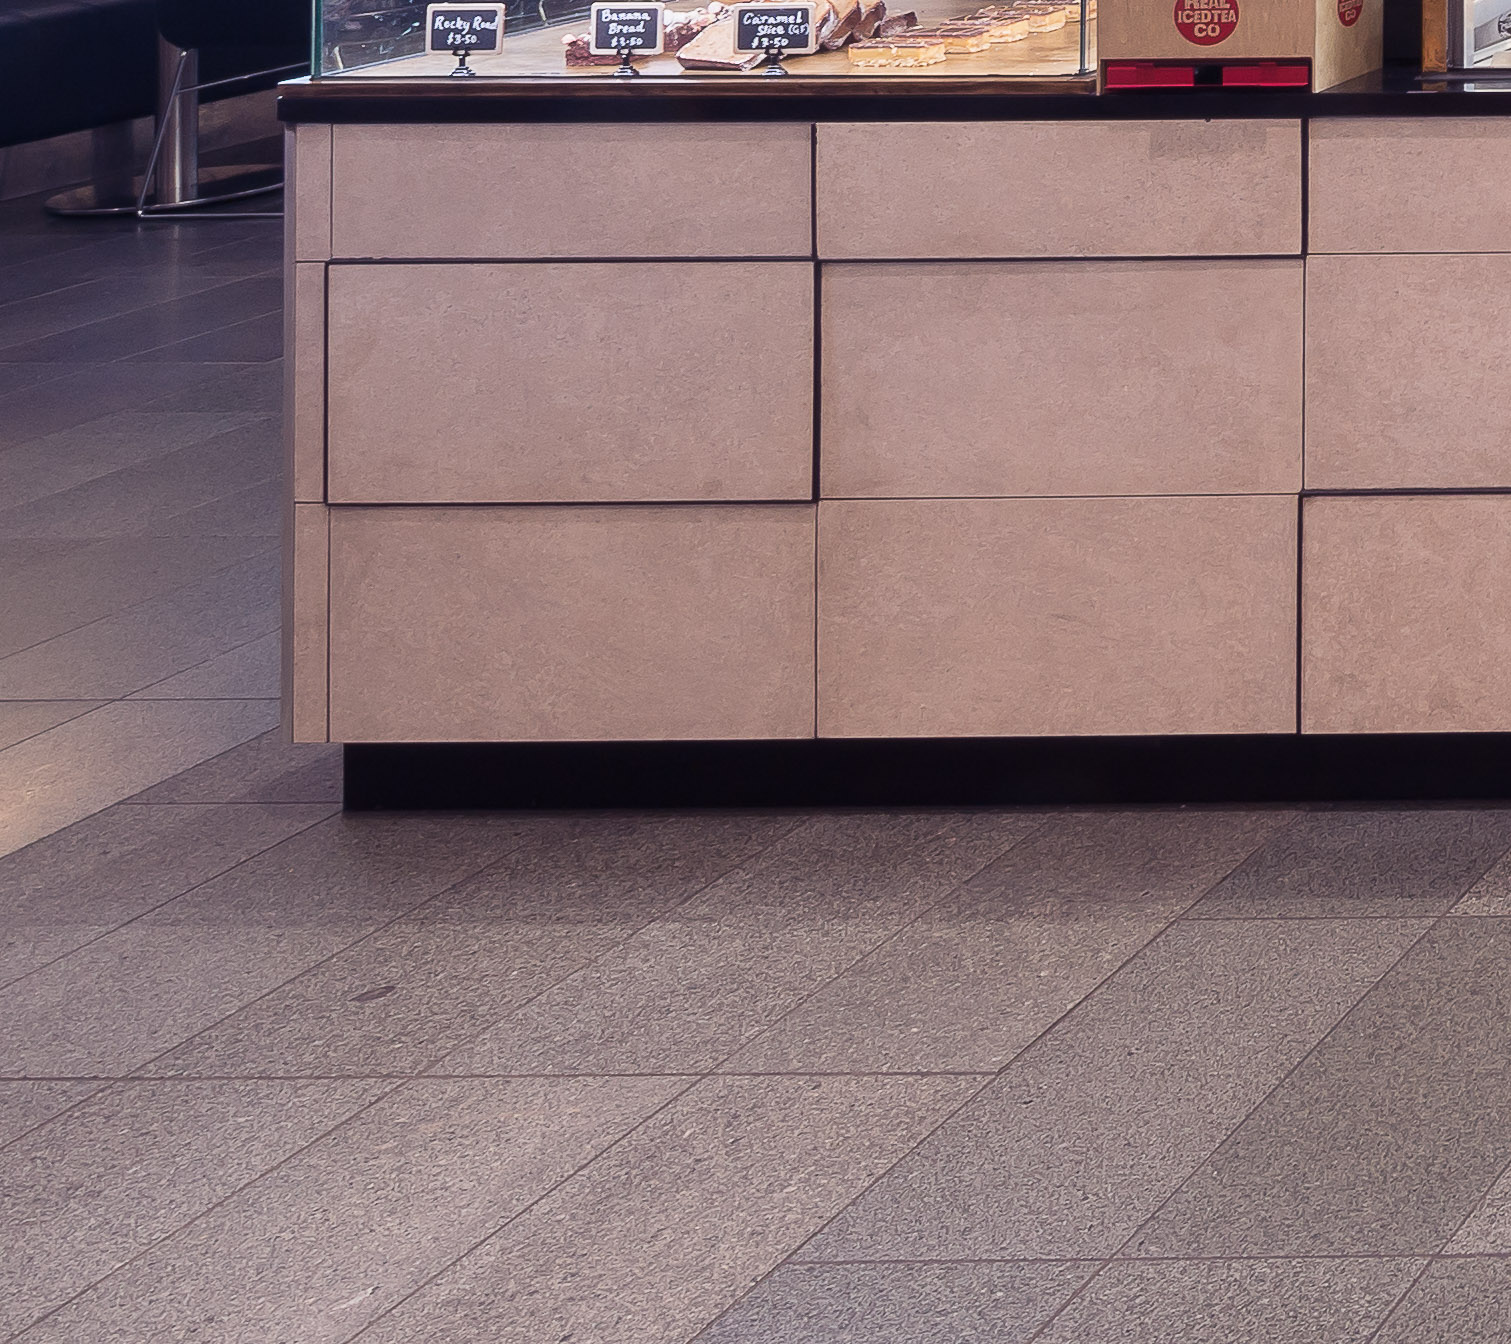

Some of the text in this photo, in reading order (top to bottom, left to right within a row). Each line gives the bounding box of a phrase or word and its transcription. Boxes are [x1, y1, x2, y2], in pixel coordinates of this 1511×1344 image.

[602, 9, 651, 22] Banana
[743, 11, 802, 25] Caramel
[434, 16, 498, 34] Rocky Road
[608, 21, 645, 34] Bread
[757, 25, 785, 36] Slice
[1194, 24, 1220, 37] CO
